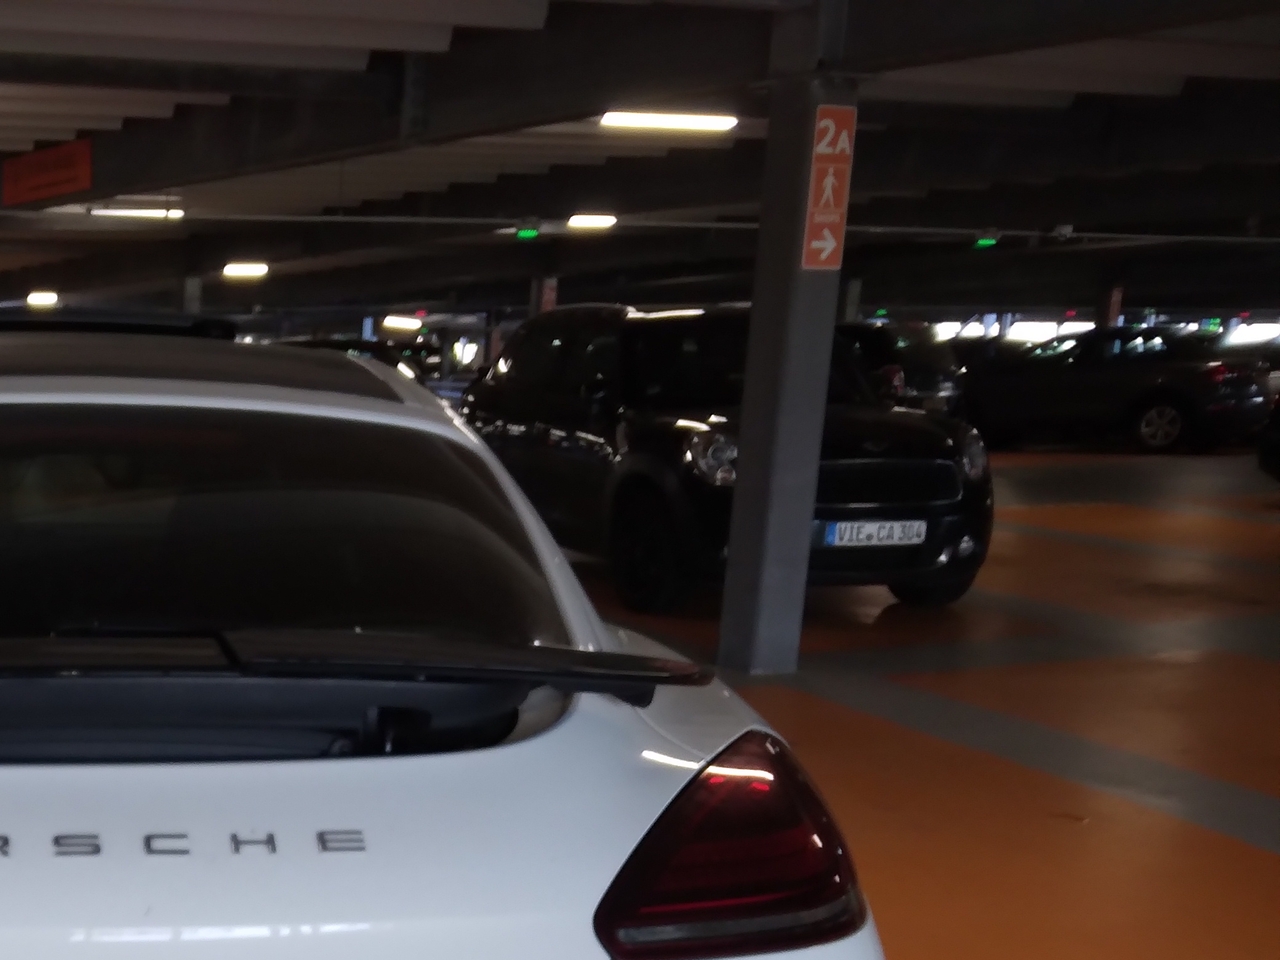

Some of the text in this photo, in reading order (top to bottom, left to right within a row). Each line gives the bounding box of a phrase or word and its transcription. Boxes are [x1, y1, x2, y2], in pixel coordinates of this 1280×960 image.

[814, 118, 851, 155] 2A
[838, 523, 865, 542] VIE
[877, 524, 895, 541] CA
